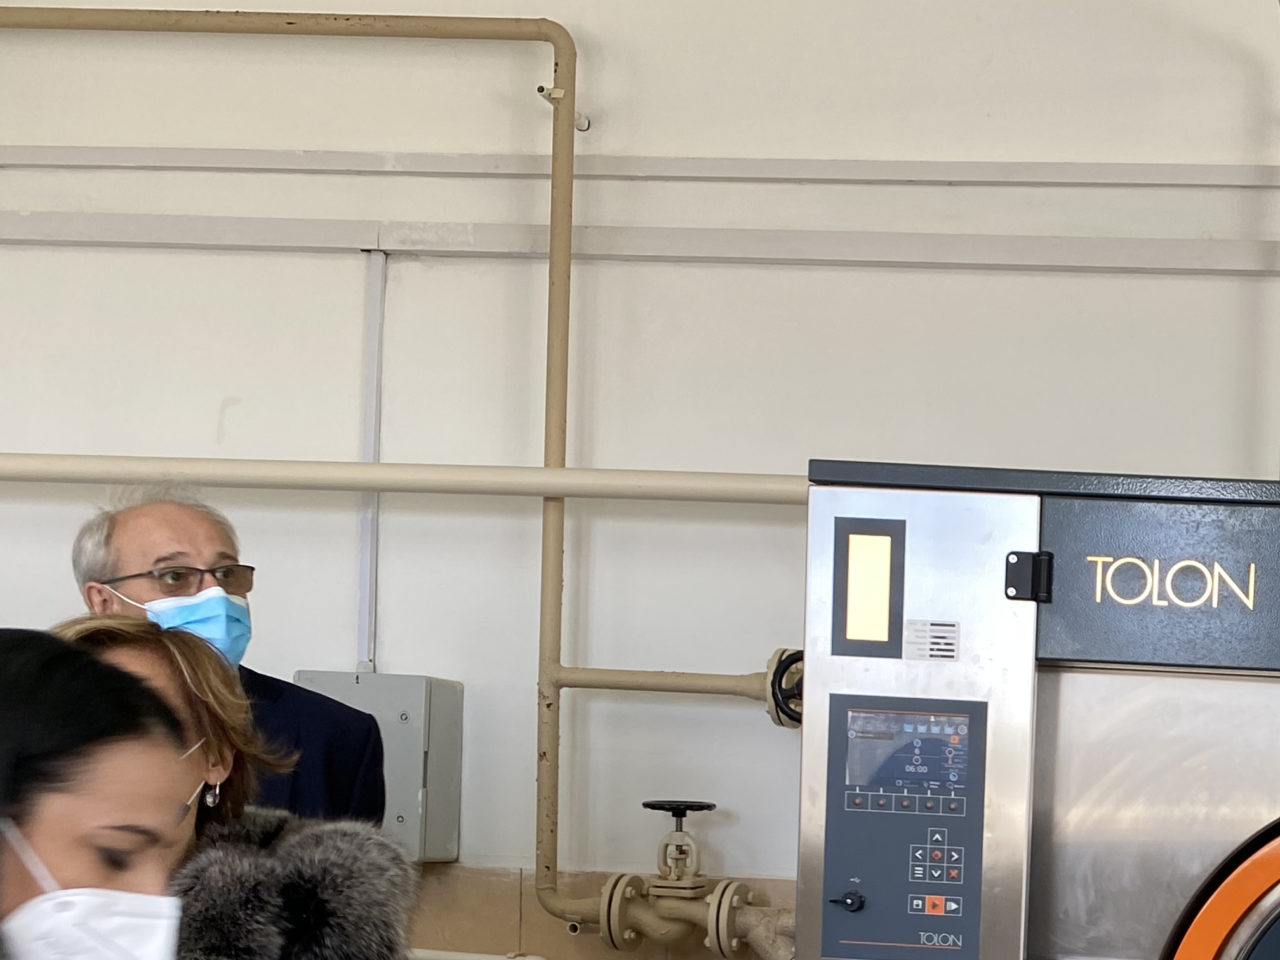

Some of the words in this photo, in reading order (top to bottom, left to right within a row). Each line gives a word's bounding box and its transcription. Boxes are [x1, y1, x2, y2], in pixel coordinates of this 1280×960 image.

[1086, 555, 1255, 611] TOLON
[905, 765, 928, 773] 06:00
[918, 932, 962, 946] TOLON
